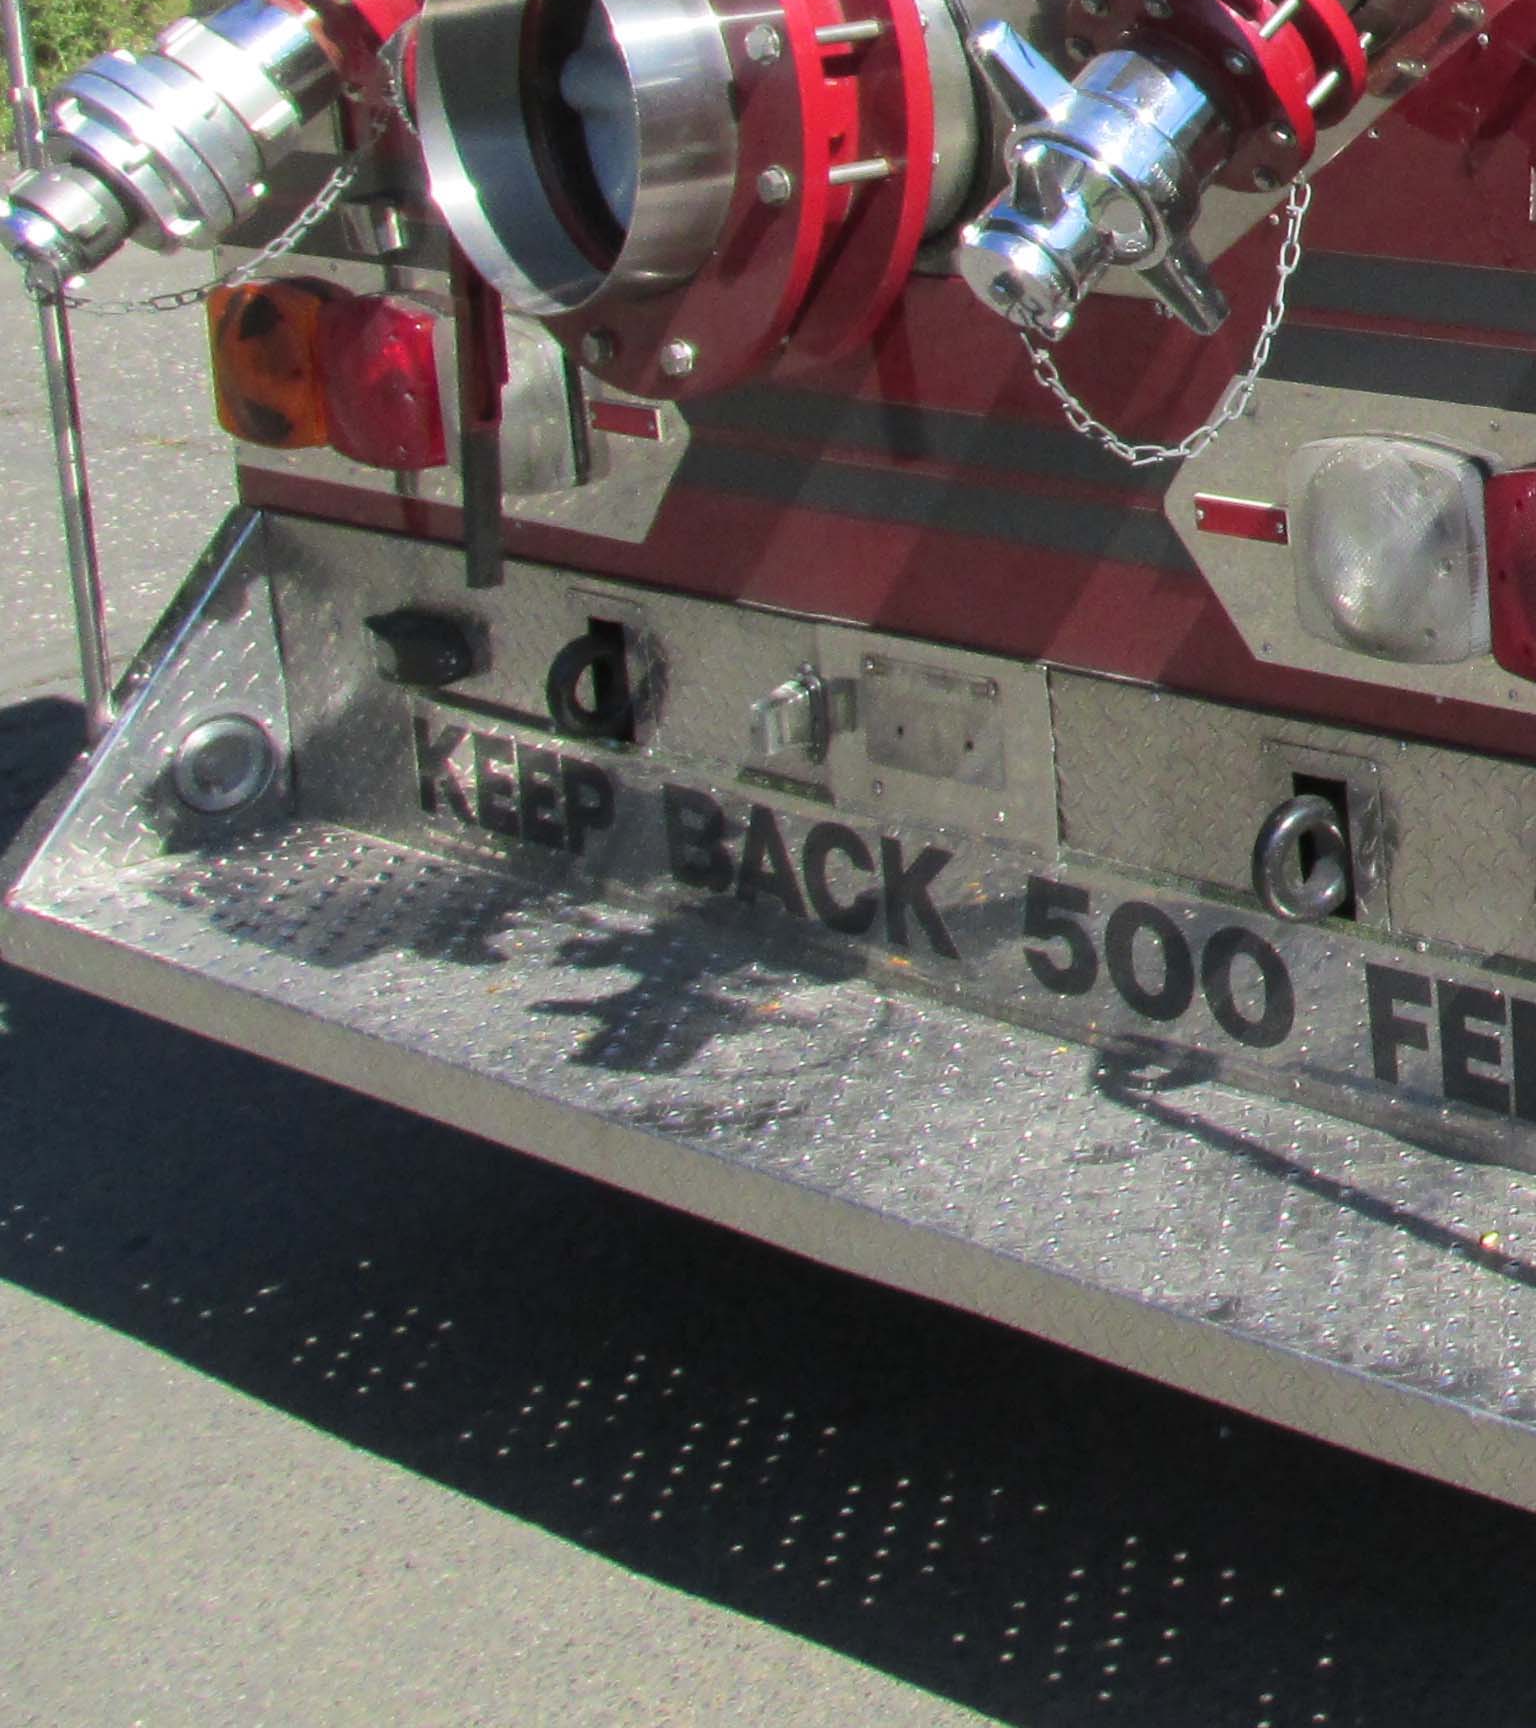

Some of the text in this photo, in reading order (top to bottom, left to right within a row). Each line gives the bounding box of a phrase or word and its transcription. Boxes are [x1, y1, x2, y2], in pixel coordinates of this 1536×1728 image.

[413, 715, 616, 854] KEEP
[662, 782, 961, 960] BACK
[1022, 874, 1295, 1049] 500
